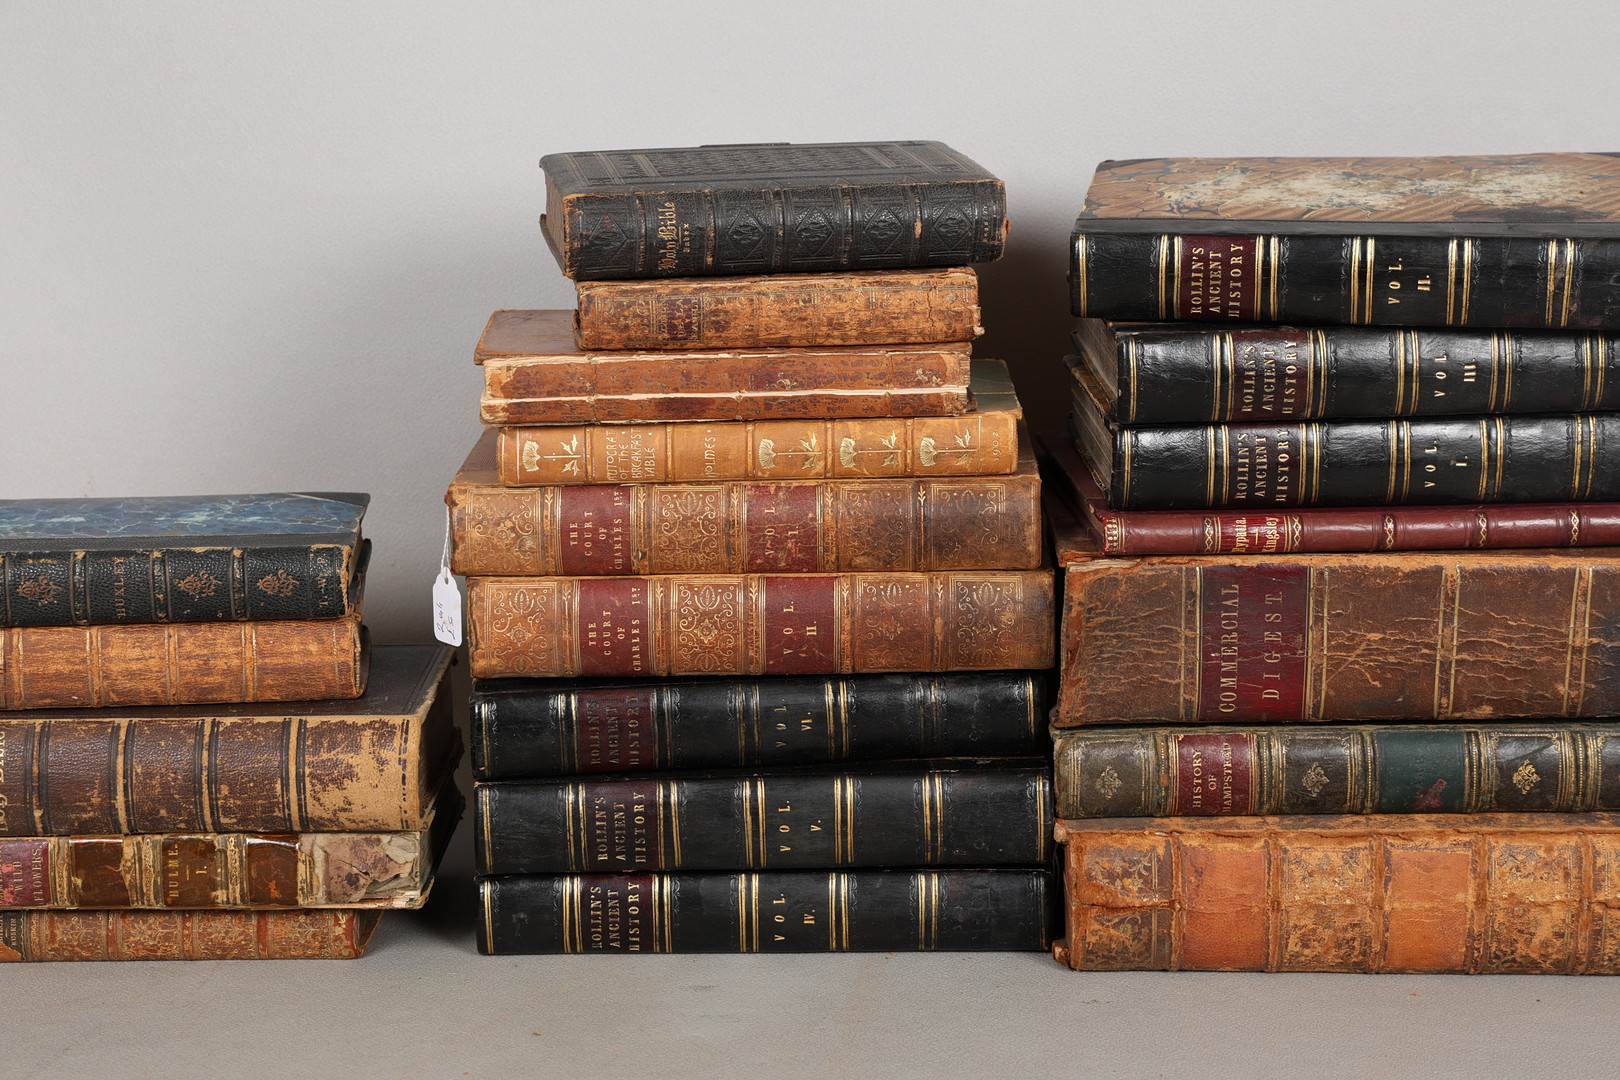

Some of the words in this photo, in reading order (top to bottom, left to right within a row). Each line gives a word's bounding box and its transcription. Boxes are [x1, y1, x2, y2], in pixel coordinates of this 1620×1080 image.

[657, 202, 678, 240] Bible
[657, 241, 679, 271] Holy
[1190, 247, 1204, 314] ROLLIN'S
[1208, 250, 1222, 313] ANCIENT
[1228, 243, 1243, 318] HISTORY
[1417, 274, 1431, 292] II.
[1241, 345, 1256, 412] ROLLIN'S
[1261, 349, 1276, 411] ANCIENT
[1281, 340, 1297, 415] HISTORY
[1463, 357, 1477, 382] III.
[605, 430, 617, 480] AUTOCRAT
[619, 467, 629, 479] OF
[630, 428, 642, 478] BREAKFAST
[643, 446, 656, 477] TABLE
[1234, 432, 1250, 499] ROLLIN'S
[1254, 434, 1268, 497] ANCIENT
[1274, 429, 1289, 502] HISTORY
[569, 522, 578, 545] THE
[584, 511, 593, 556] COURT
[598, 527, 607, 540] OF
[613, 518, 623, 570] CHARLES
[1262, 516, 1280, 553] Kingsley
[112, 556, 126, 617] HUXLEY
[588, 622, 597, 646] THE
[603, 610, 612, 656] COURT
[617, 626, 626, 640] OF
[631, 619, 642, 671] CHARLES
[806, 620, 817, 636] II.
[1219, 583, 1239, 713] COMMERCIAL
[586, 701, 601, 765] ROLLIN'S
[605, 705, 620, 764] ANCIENT
[625, 695, 640, 765] HISTORY
[800, 712, 813, 731] VI.
[1192, 748, 1202, 808] HISTORY
[1208, 774, 1217, 790] OF
[1222, 742, 1232, 813] HAMPSTEAD
[594, 796, 609, 861] ROLLIN'S
[613, 801, 626, 861] ANCIENT
[633, 792, 646, 863] HISTORY
[810, 820, 822, 831] V.
[13, 861, 23, 891] WILD
[590, 886, 603, 949] ROLLIN'S
[607, 889, 621, 948] ANCIENT
[627, 882, 640, 951] HISTORY
[803, 909, 815, 925] IV.
